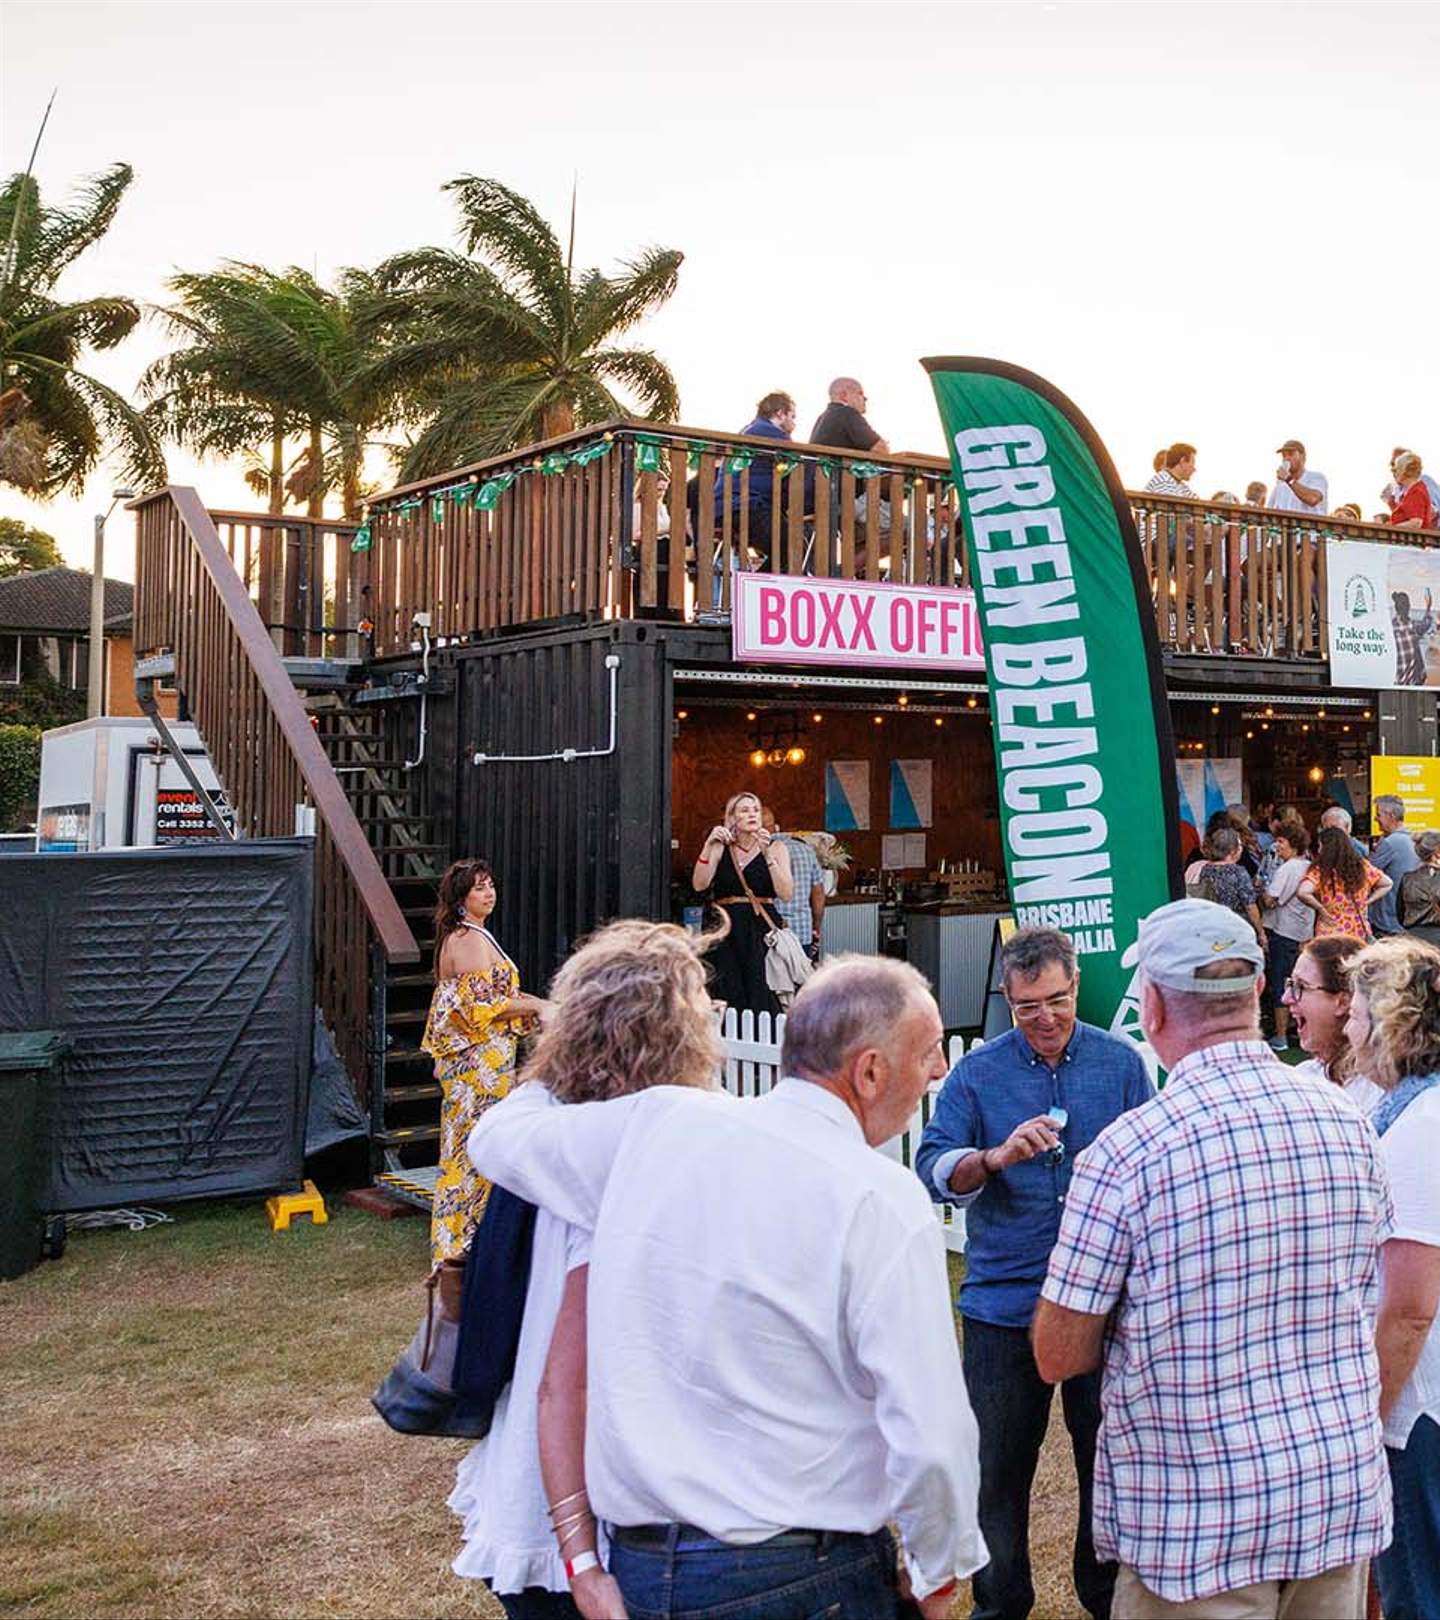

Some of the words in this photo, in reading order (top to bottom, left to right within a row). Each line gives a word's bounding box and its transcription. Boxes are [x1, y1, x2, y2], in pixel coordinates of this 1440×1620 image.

[954, 424, 1081, 628] GREEN
[760, 587, 876, 651] BOXX
[1337, 626, 1365, 640] Take
[1367, 628, 1385, 641] the
[1335, 639, 1361, 656] long
[1363, 643, 1388, 656] way.
[990, 636, 1114, 903] BEACON
[158, 801, 204, 814] rentals
[1016, 898, 1114, 930] BRISBANE
